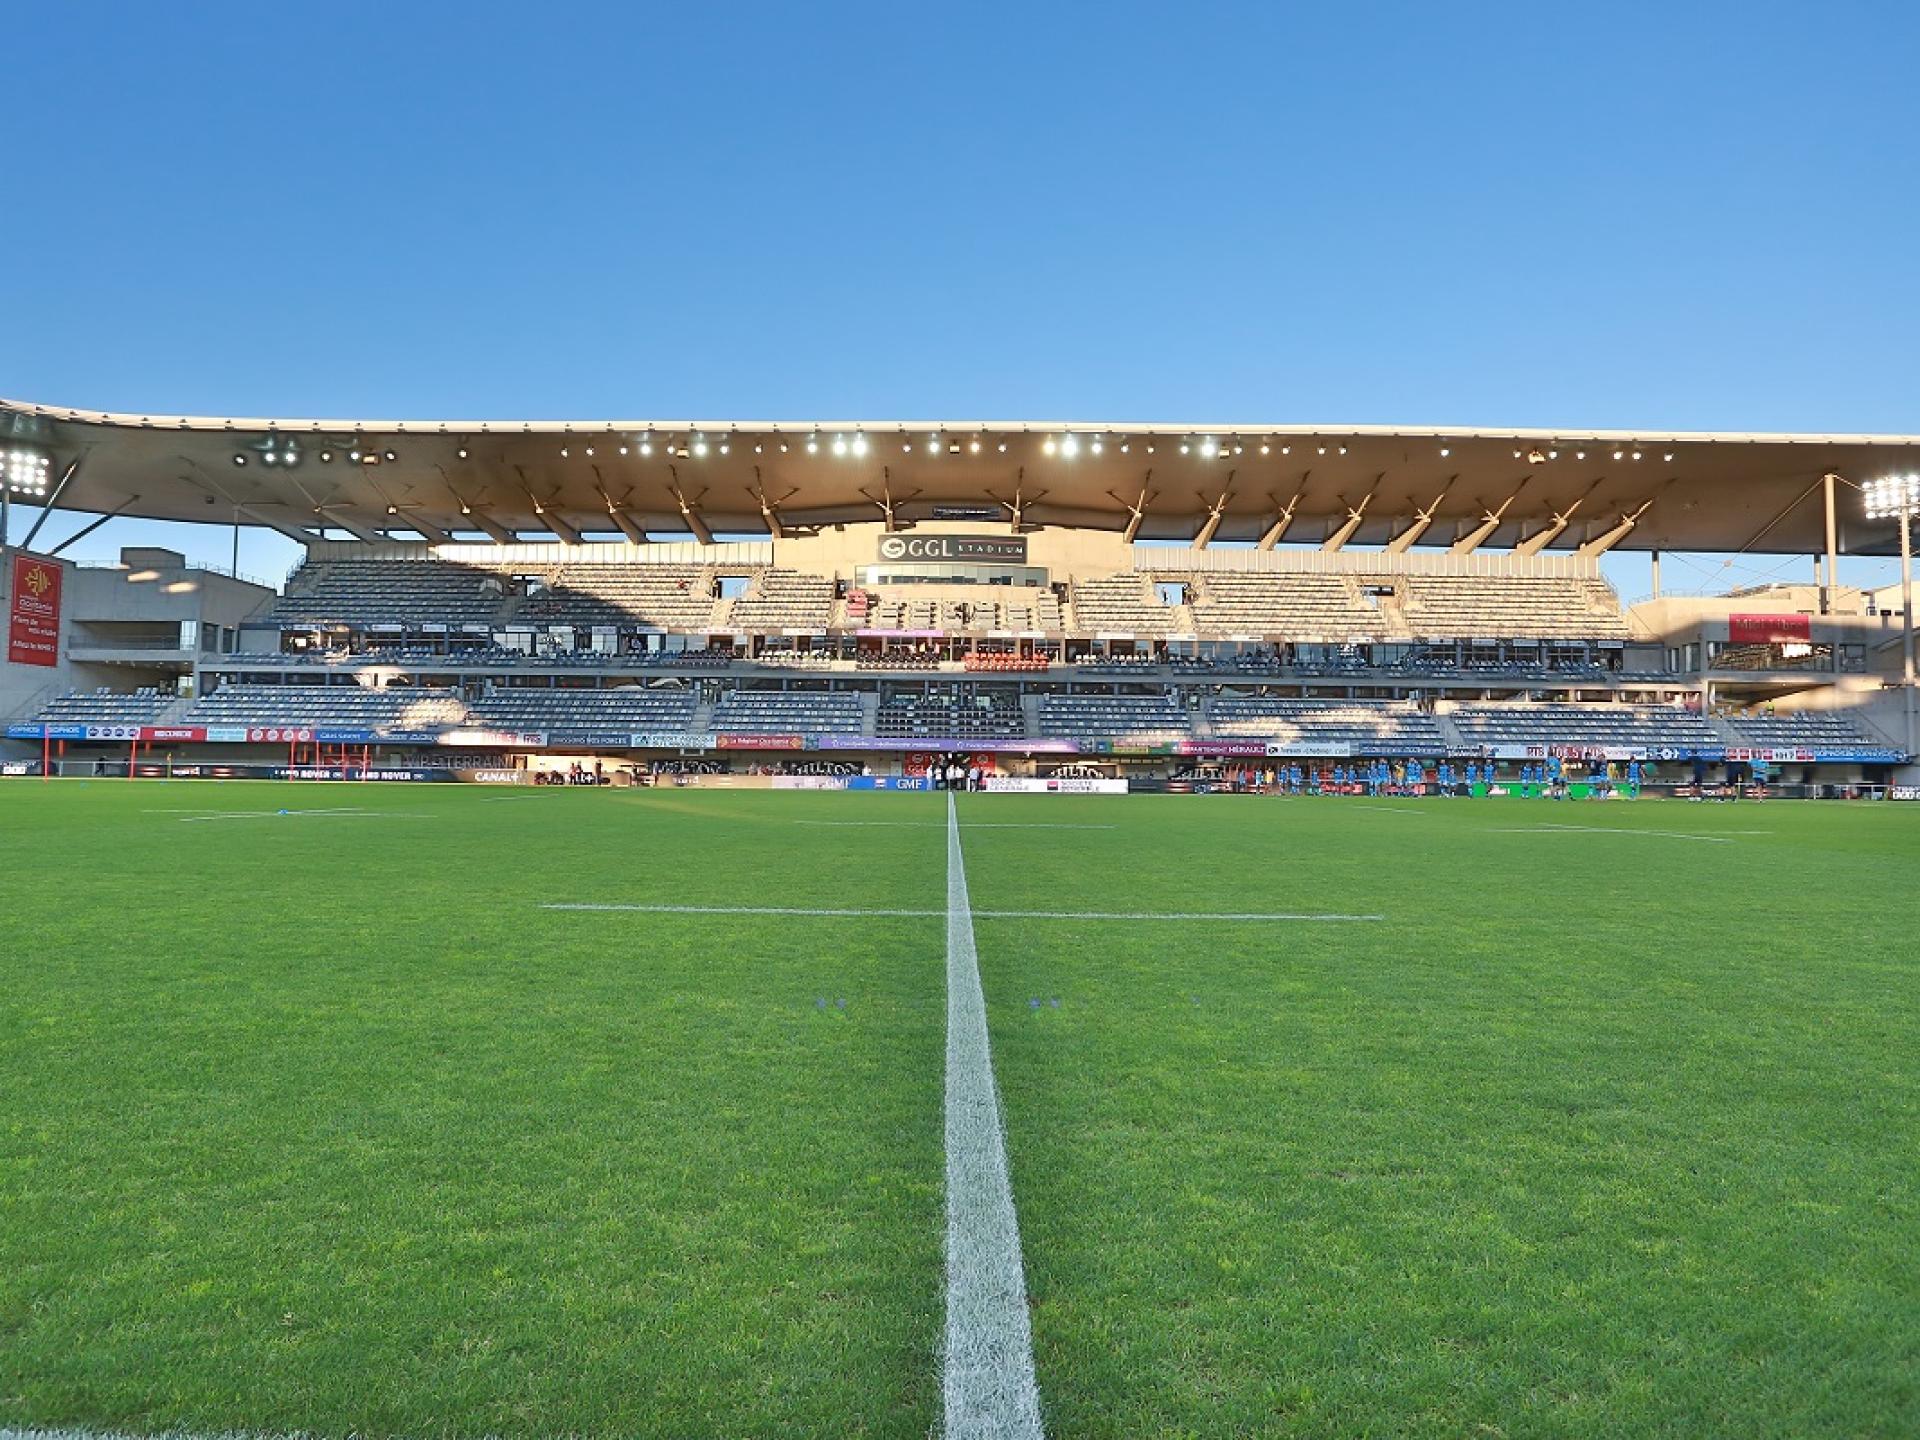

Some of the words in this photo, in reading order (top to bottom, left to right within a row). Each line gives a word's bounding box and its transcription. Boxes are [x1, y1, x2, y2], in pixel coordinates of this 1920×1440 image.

[908, 539, 953, 557] GGL
[958, 544, 1023, 554] STADIUM
[474, 772, 519, 783] CANAL+
[896, 779, 922, 789] GMF
